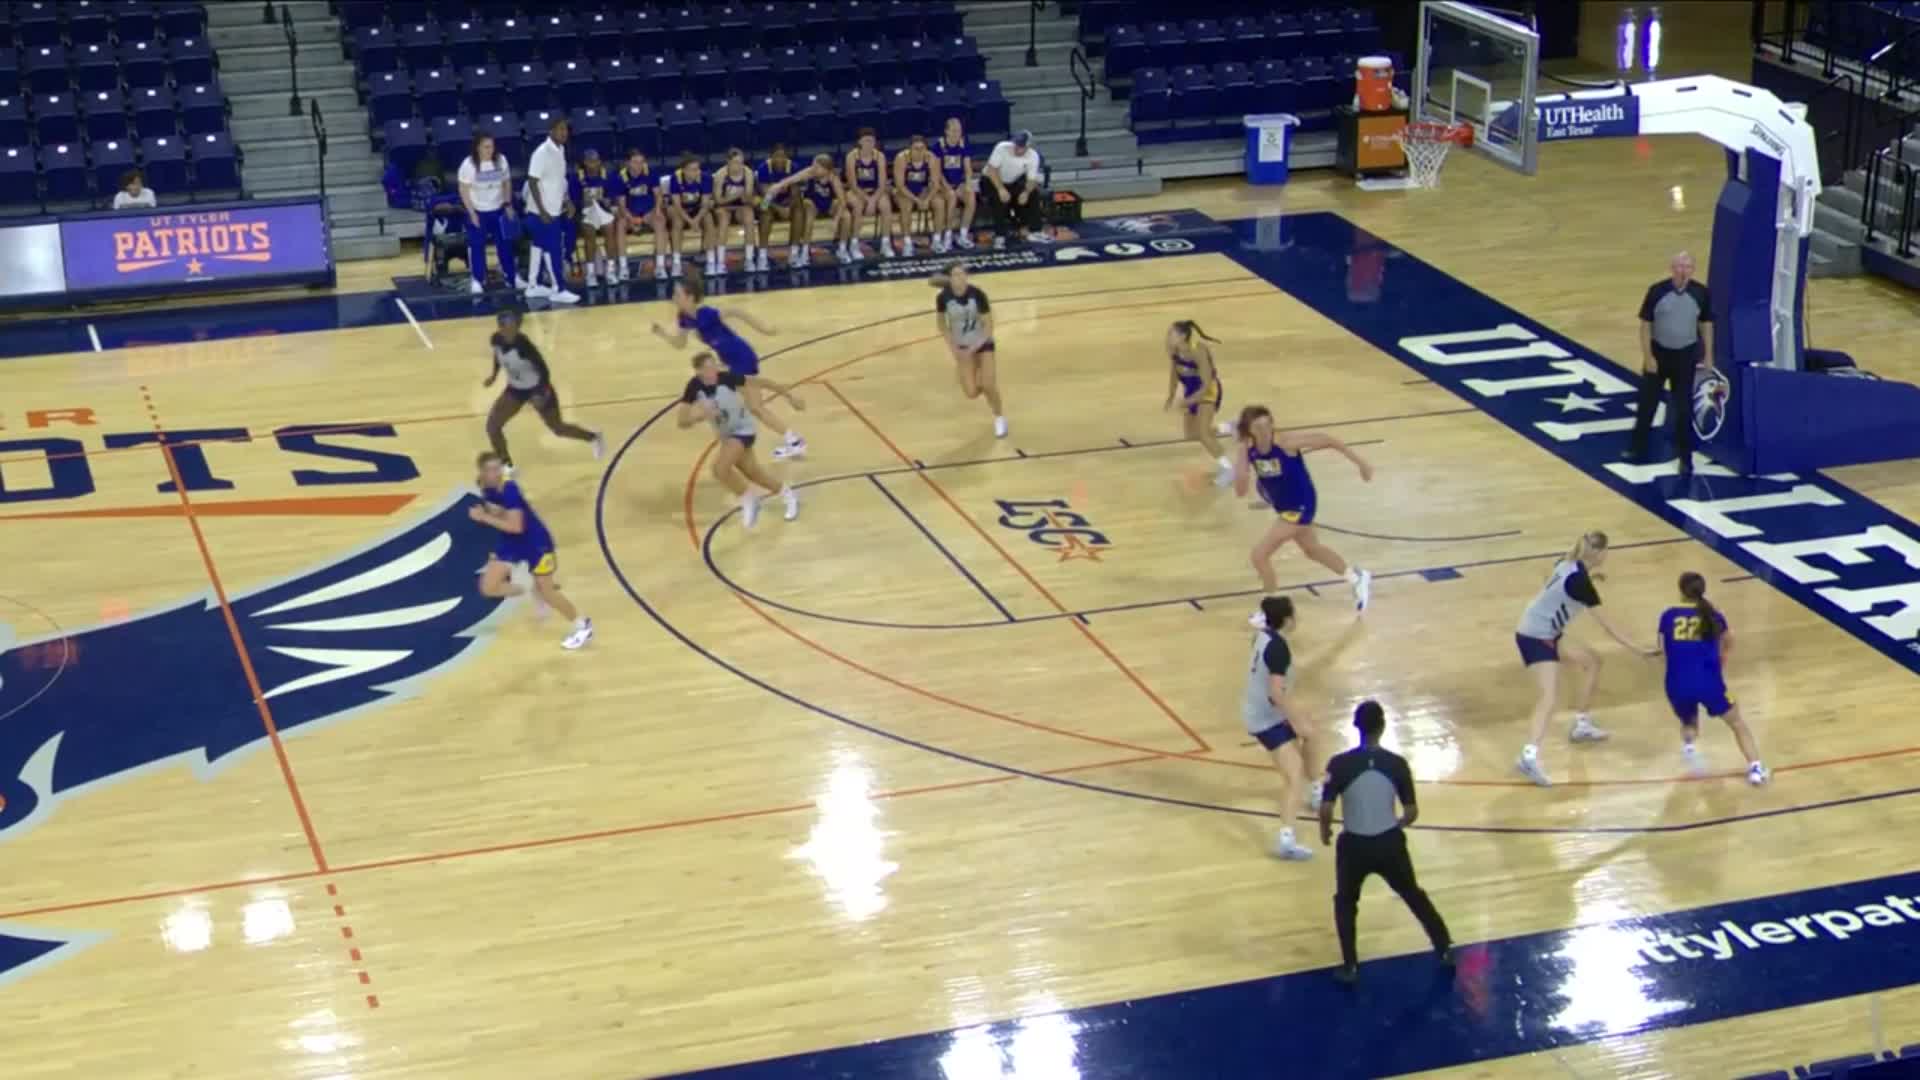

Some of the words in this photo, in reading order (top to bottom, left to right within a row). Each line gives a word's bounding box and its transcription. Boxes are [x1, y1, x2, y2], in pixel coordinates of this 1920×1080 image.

[1545, 103, 1624, 126] UTHealth
[1546, 127, 1566, 138] East
[151, 215, 171, 227] UT
[176, 211, 230, 225] TYLER
[114, 222, 270, 261] PATRIOTS
[1398, 323, 1638, 397] UT
[1673, 616, 1702, 640] 22
[1633, 895, 1920, 962] ttylerpat
